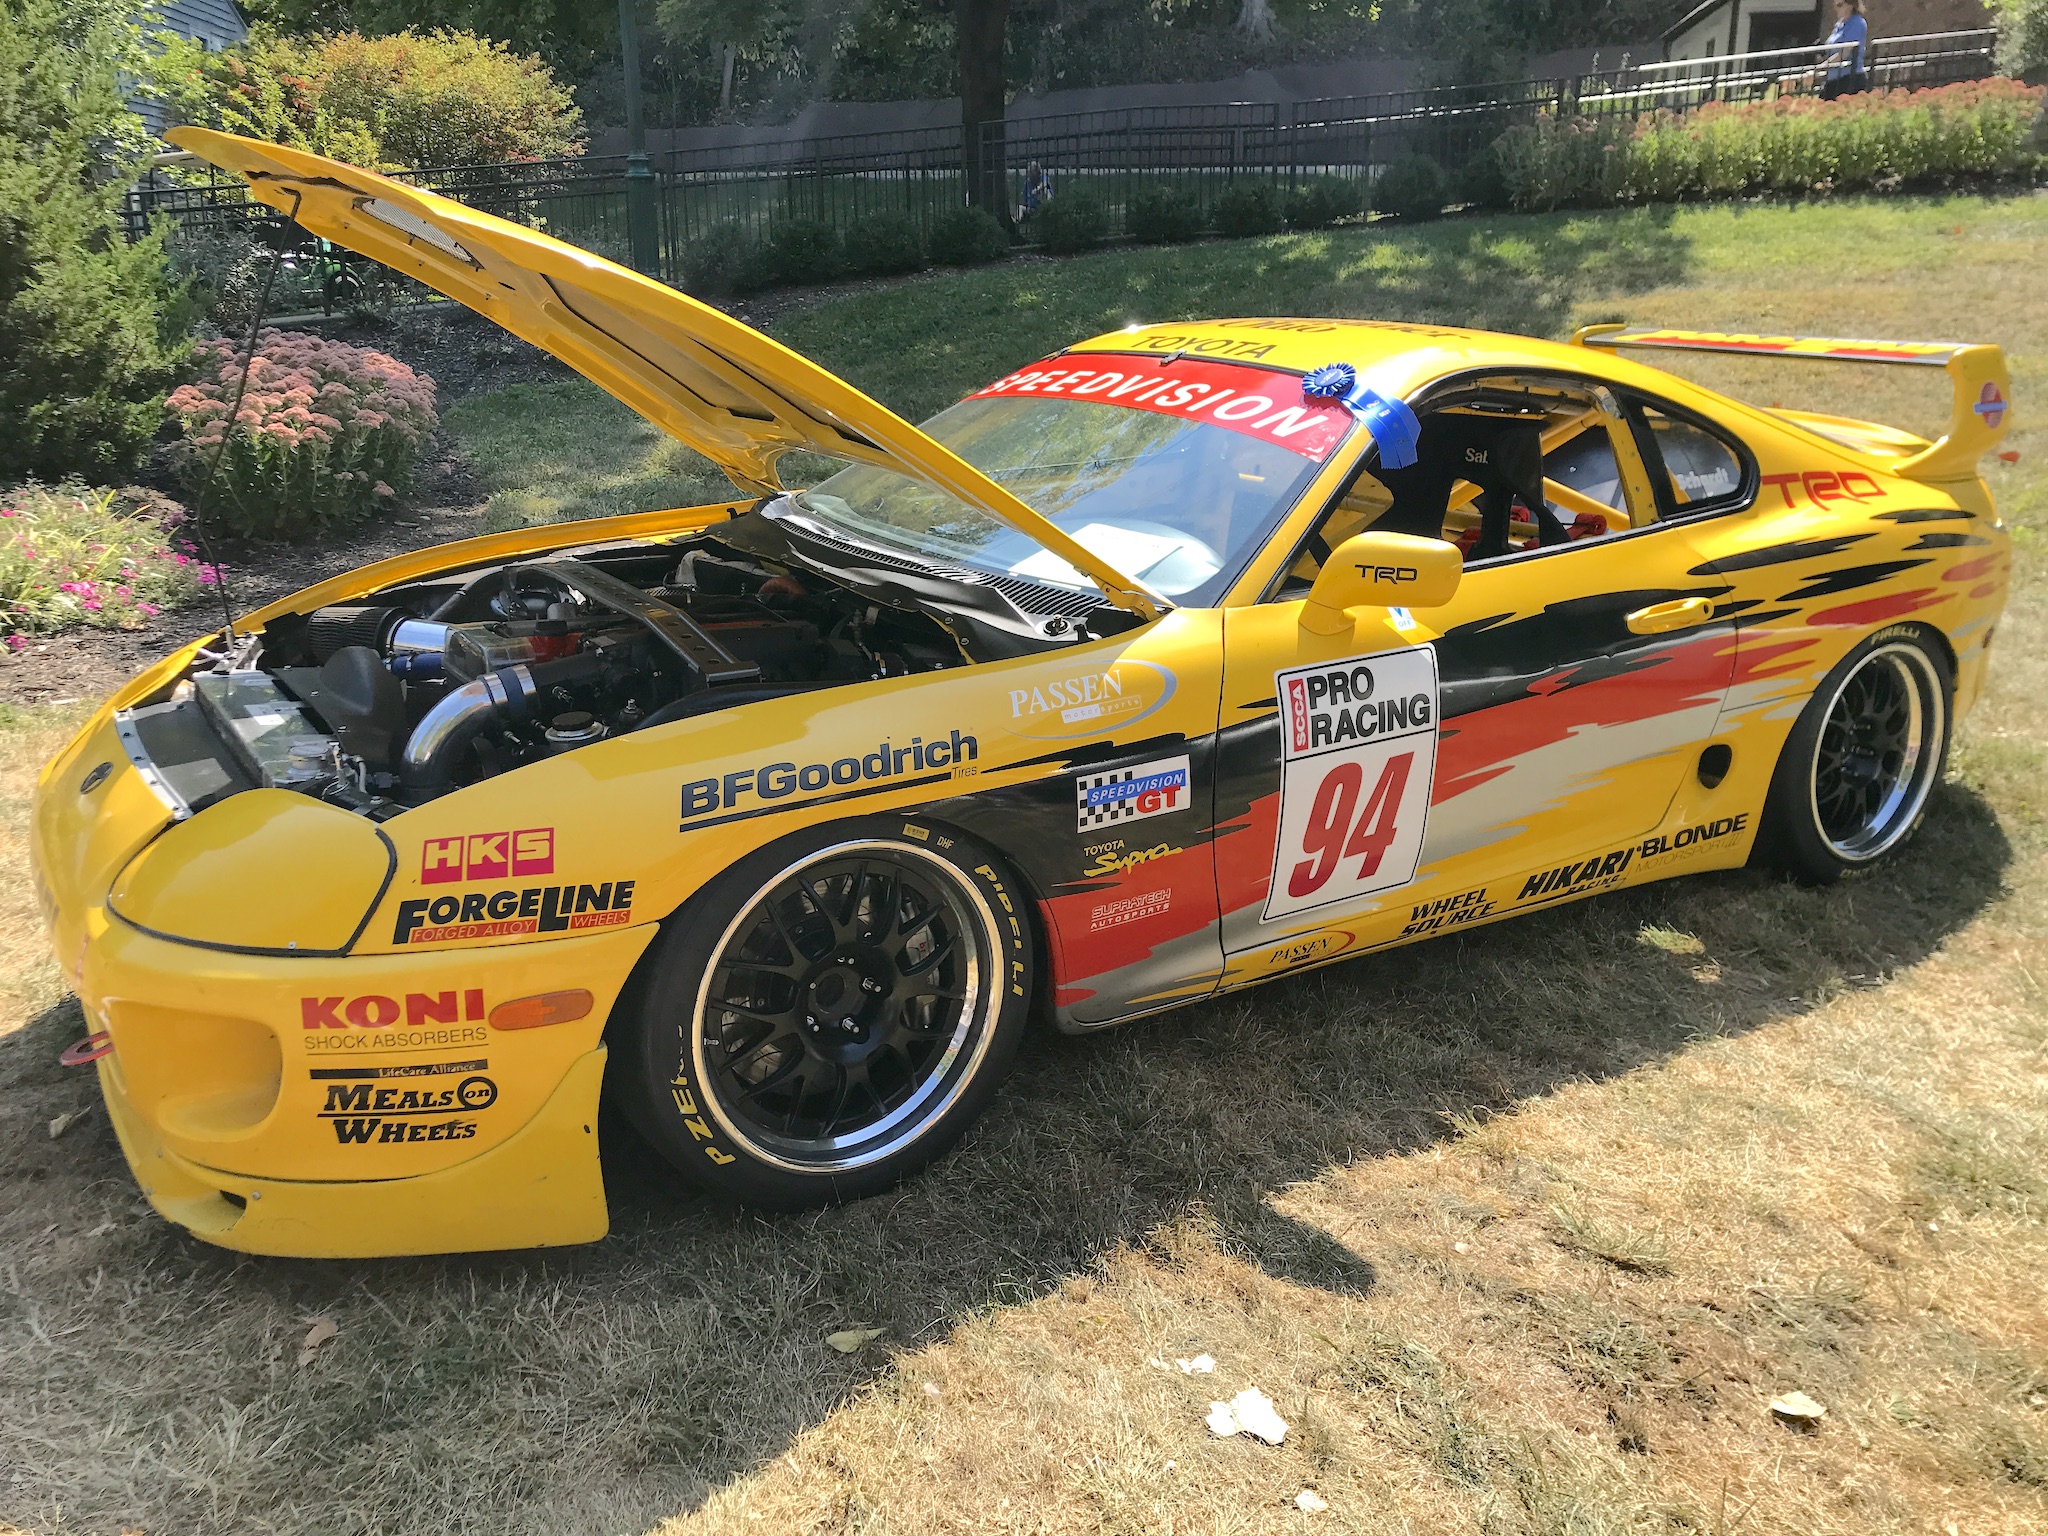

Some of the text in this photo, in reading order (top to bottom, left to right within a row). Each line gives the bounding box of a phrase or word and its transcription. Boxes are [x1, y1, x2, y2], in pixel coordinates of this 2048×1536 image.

[1130, 336, 1278, 360] TOYOTA
[979, 370, 1328, 438] SPEEDVISION
[1761, 471, 1888, 512] TRD
[1354, 564, 1418, 585] TRD
[1871, 625, 1920, 645] PIRELLI
[1008, 669, 1122, 718] PASSEN
[1306, 666, 1374, 710] PRO
[1291, 683, 1309, 747] SCCA
[1311, 693, 1431, 748] RACING
[681, 729, 978, 819] BFGoodrich
[951, 765, 978, 780] Tires
[1090, 773, 1184, 803] SPEEDVISION
[1136, 785, 1181, 814] GT
[1287, 751, 1415, 898] 94
[1641, 813, 1749, 859] BLONDE
[422, 829, 553, 876] HKS
[936, 835, 955, 850] DHF
[1083, 839, 1125, 857] TOYOTA
[1083, 842, 1184, 877] Supra
[1516, 848, 1635, 901] HIKARI
[392, 880, 636, 944] FORGELINE
[1090, 902, 1170, 930] AUTOSPORTS
[1091, 887, 1172, 919] SUPRATECH
[1401, 900, 1497, 936] SOURCE
[1410, 887, 1487, 922] WHEEL
[413, 920, 534, 943] FORGED ALLOY
[573, 911, 628, 928] WHEELS
[1269, 936, 1333, 964] PASSEN
[301, 988, 485, 1030] KONI
[304, 1026, 488, 1050] SHOCK ABSORBERS
[378, 1062, 476, 1078] LifeCare Alliance
[323, 1084, 491, 1111] MEALS on
[333, 1118, 478, 1144] WHEELS
